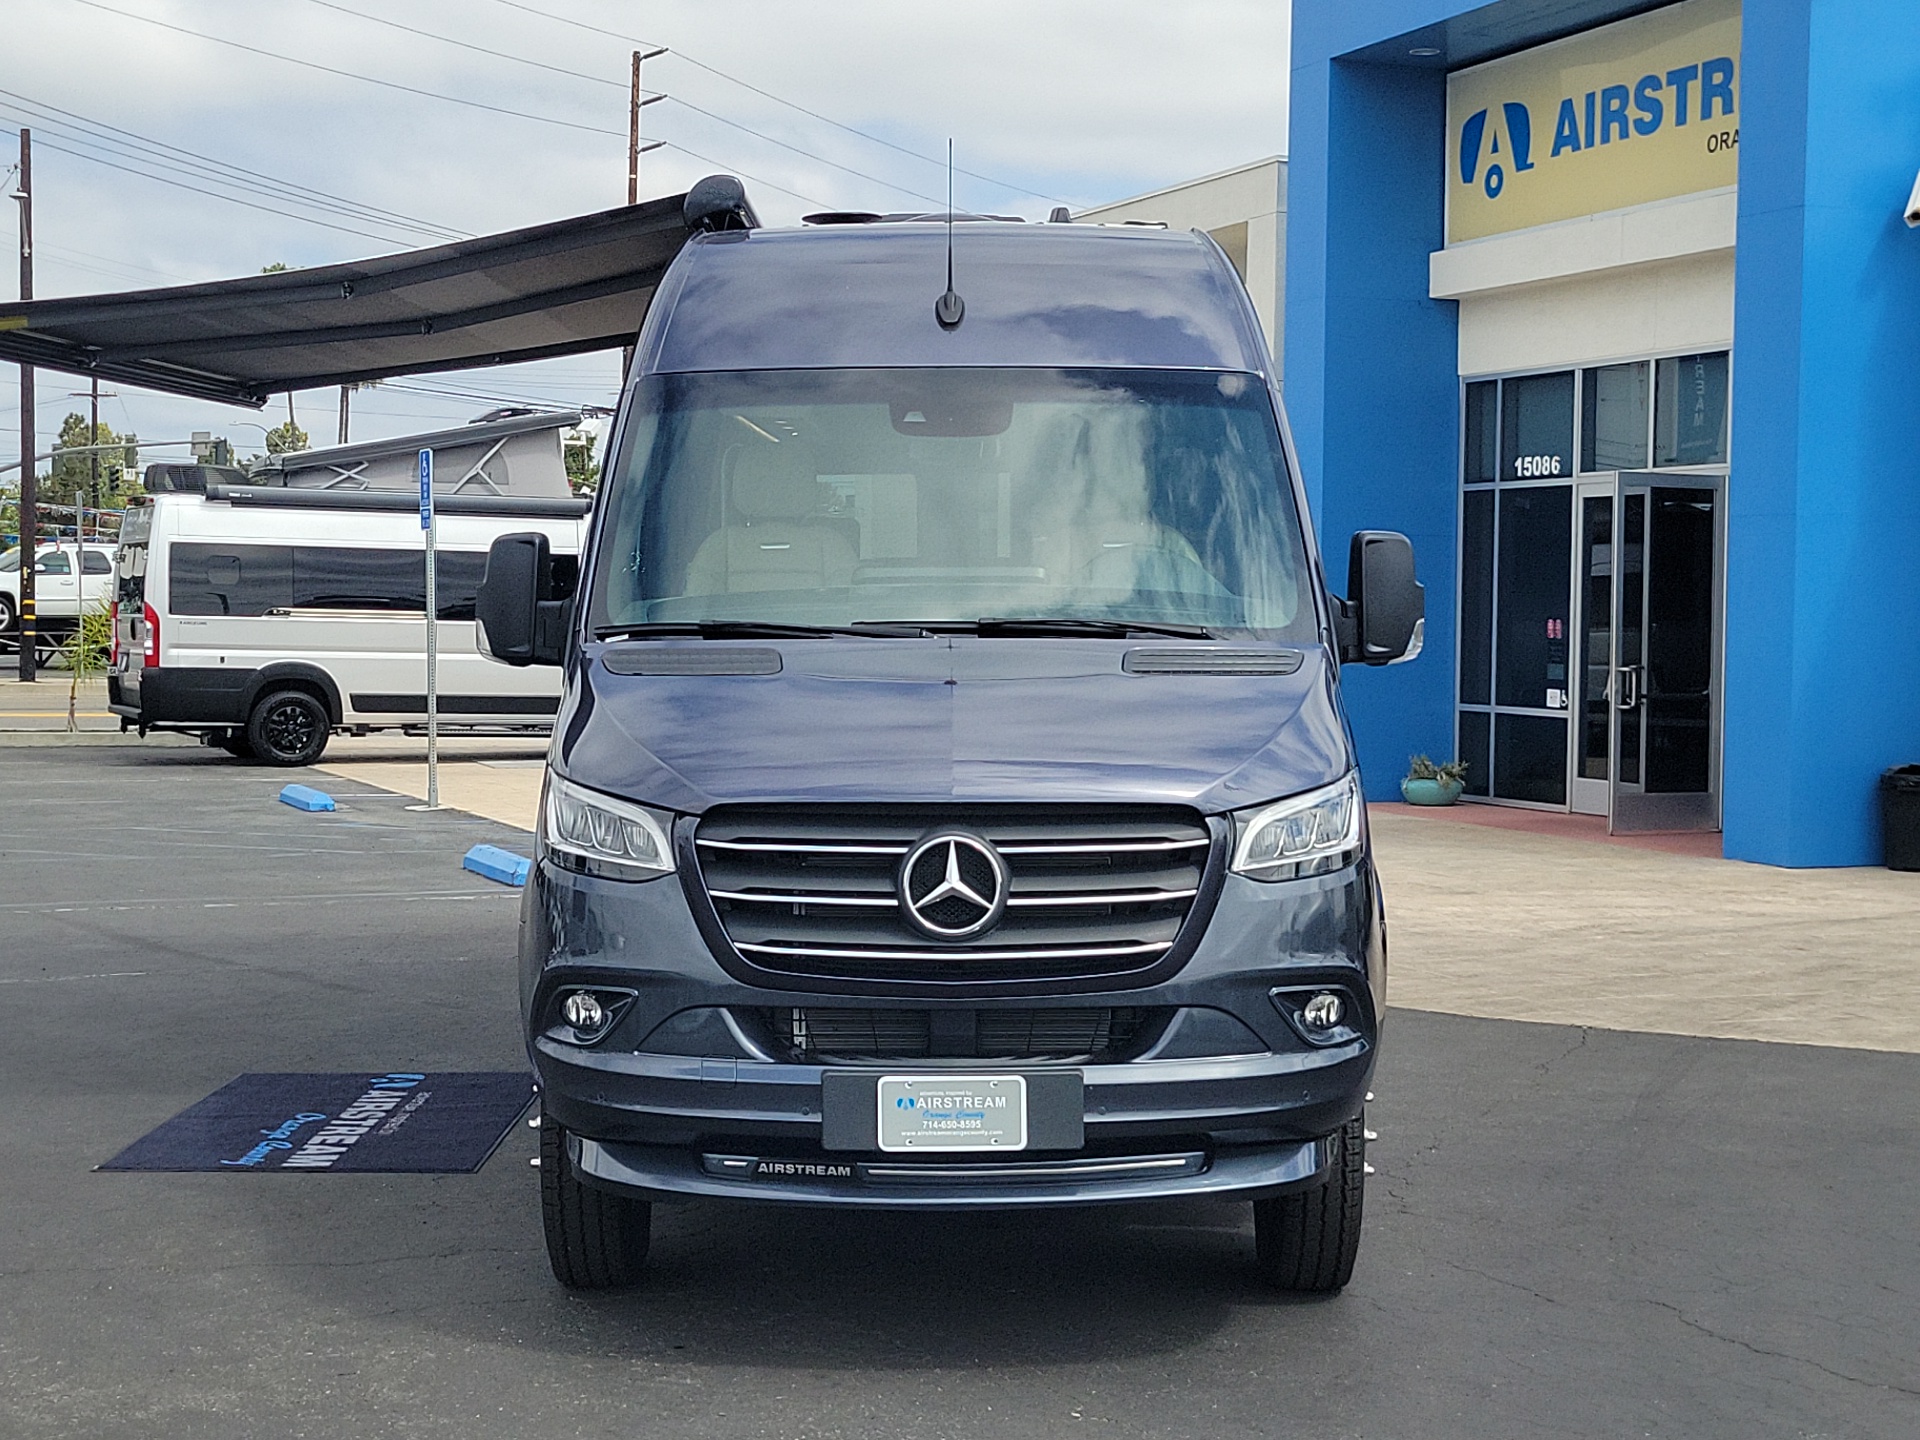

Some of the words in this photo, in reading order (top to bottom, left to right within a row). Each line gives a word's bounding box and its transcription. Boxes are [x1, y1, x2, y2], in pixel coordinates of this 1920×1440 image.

[1550, 56, 1734, 157] AIRSTR
[1514, 455, 1561, 477] 15086
[917, 1097, 1006, 1108] AIRSTREAM
[281, 1089, 409, 1167] AIRSTREAM
[757, 1163, 851, 1177] AIRSTREAM
